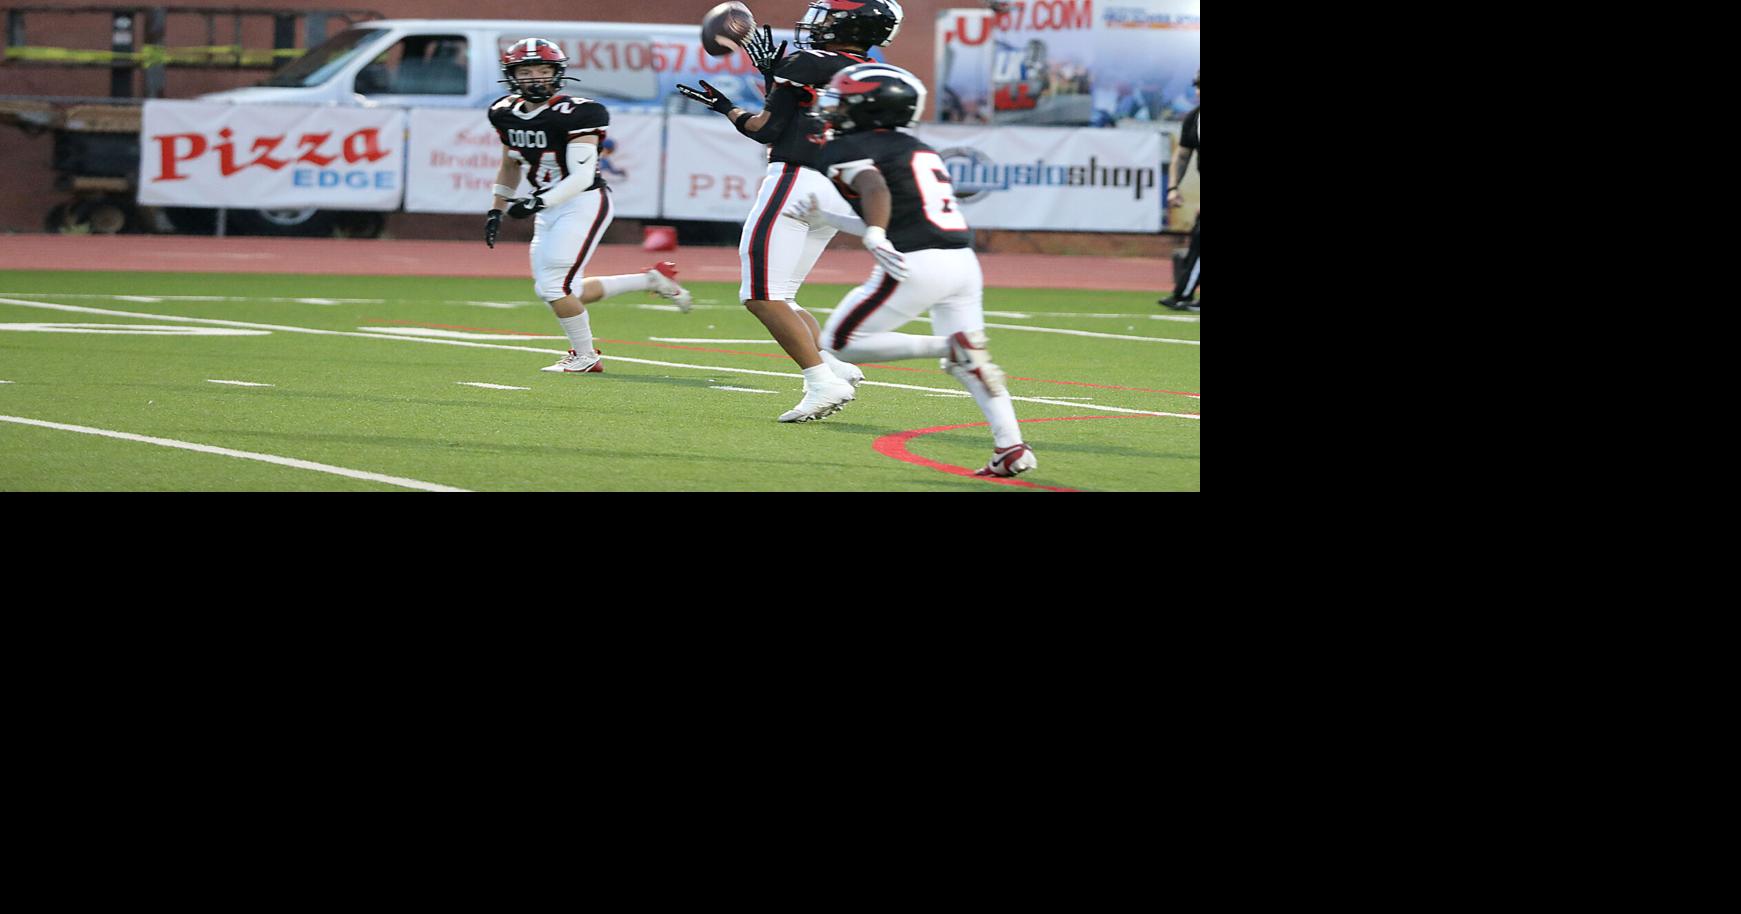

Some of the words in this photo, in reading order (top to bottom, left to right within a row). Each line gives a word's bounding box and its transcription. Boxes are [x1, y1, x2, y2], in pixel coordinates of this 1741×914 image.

[507, 129, 548, 149] COCO
[152, 127, 393, 183] Pizza
[293, 168, 396, 189] EDGE
[687, 172, 765, 200] PR
[910, 150, 969, 231] 6
